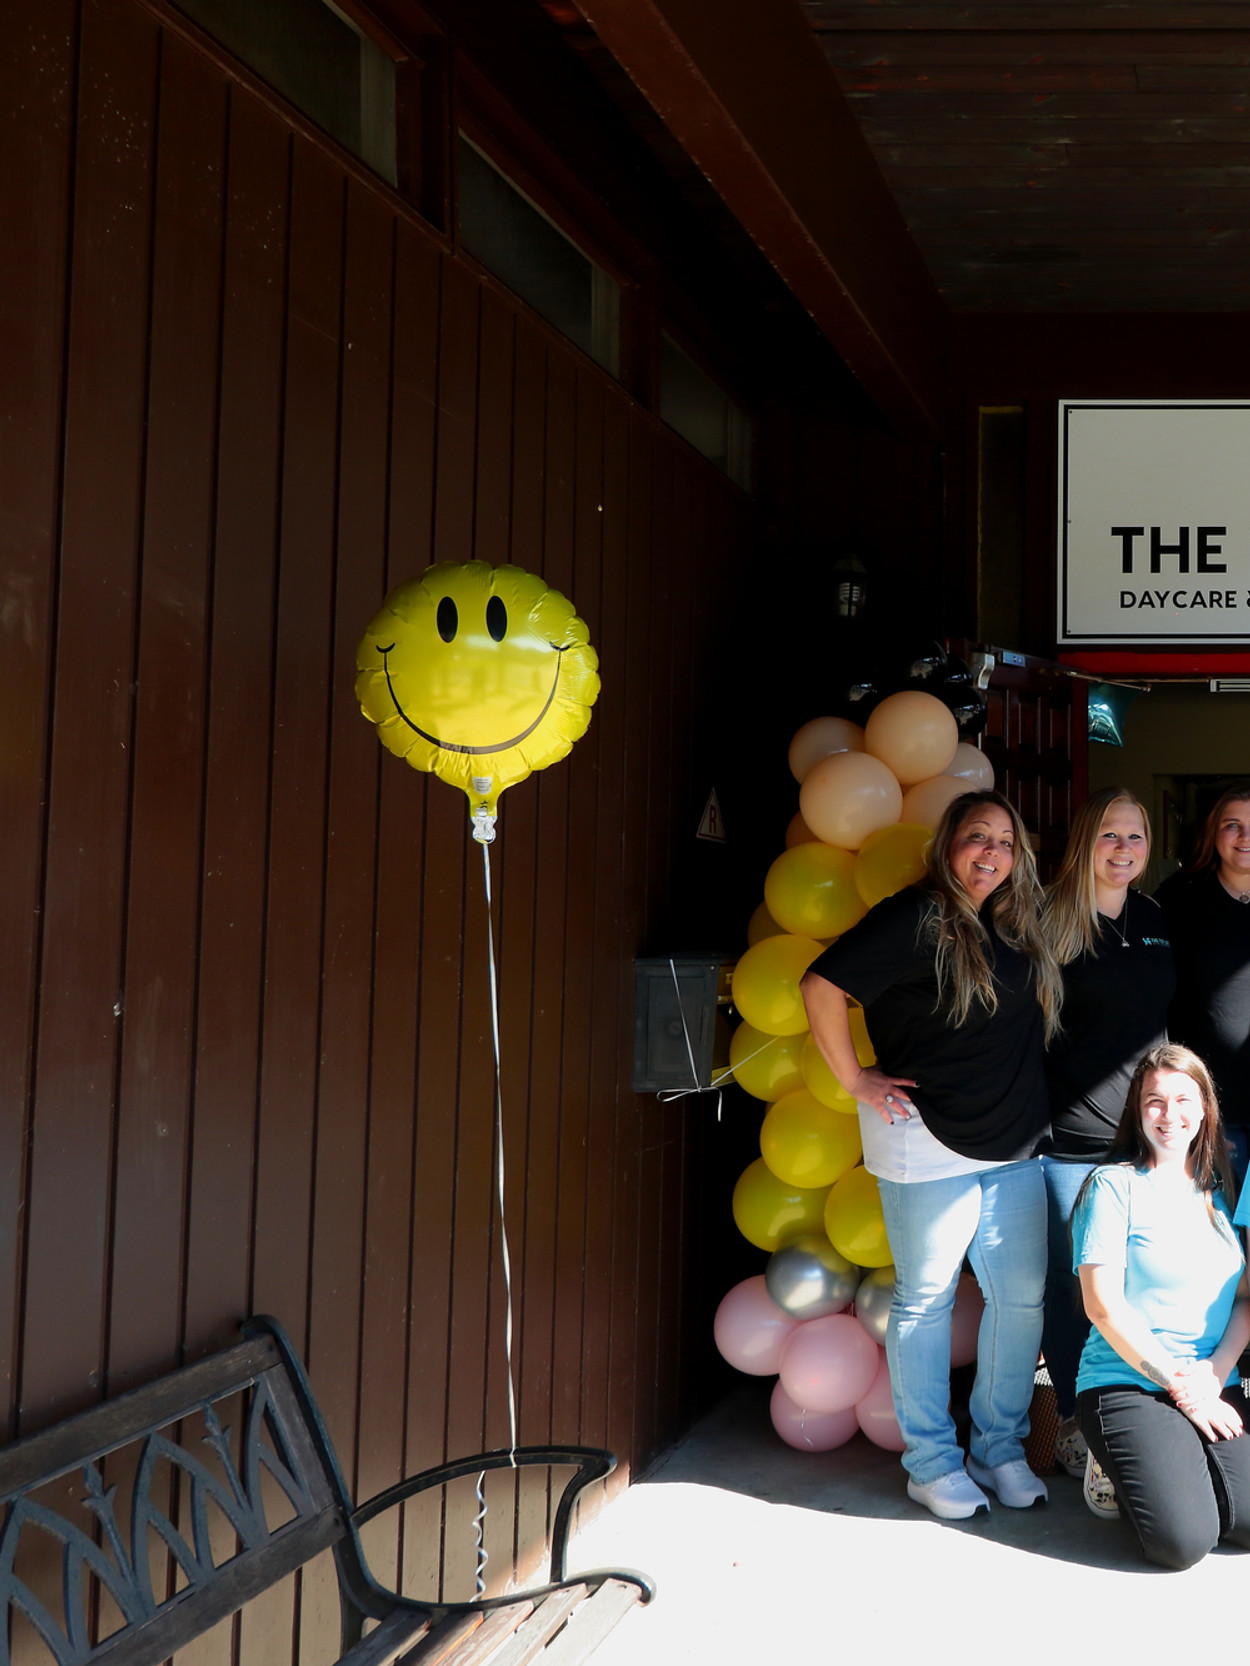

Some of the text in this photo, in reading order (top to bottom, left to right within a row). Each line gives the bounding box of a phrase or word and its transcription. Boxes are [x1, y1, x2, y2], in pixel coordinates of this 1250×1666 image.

[1110, 526, 1227, 574] THE
[1120, 590, 1237, 609] DAYCARE
[709, 805, 717, 834] R
